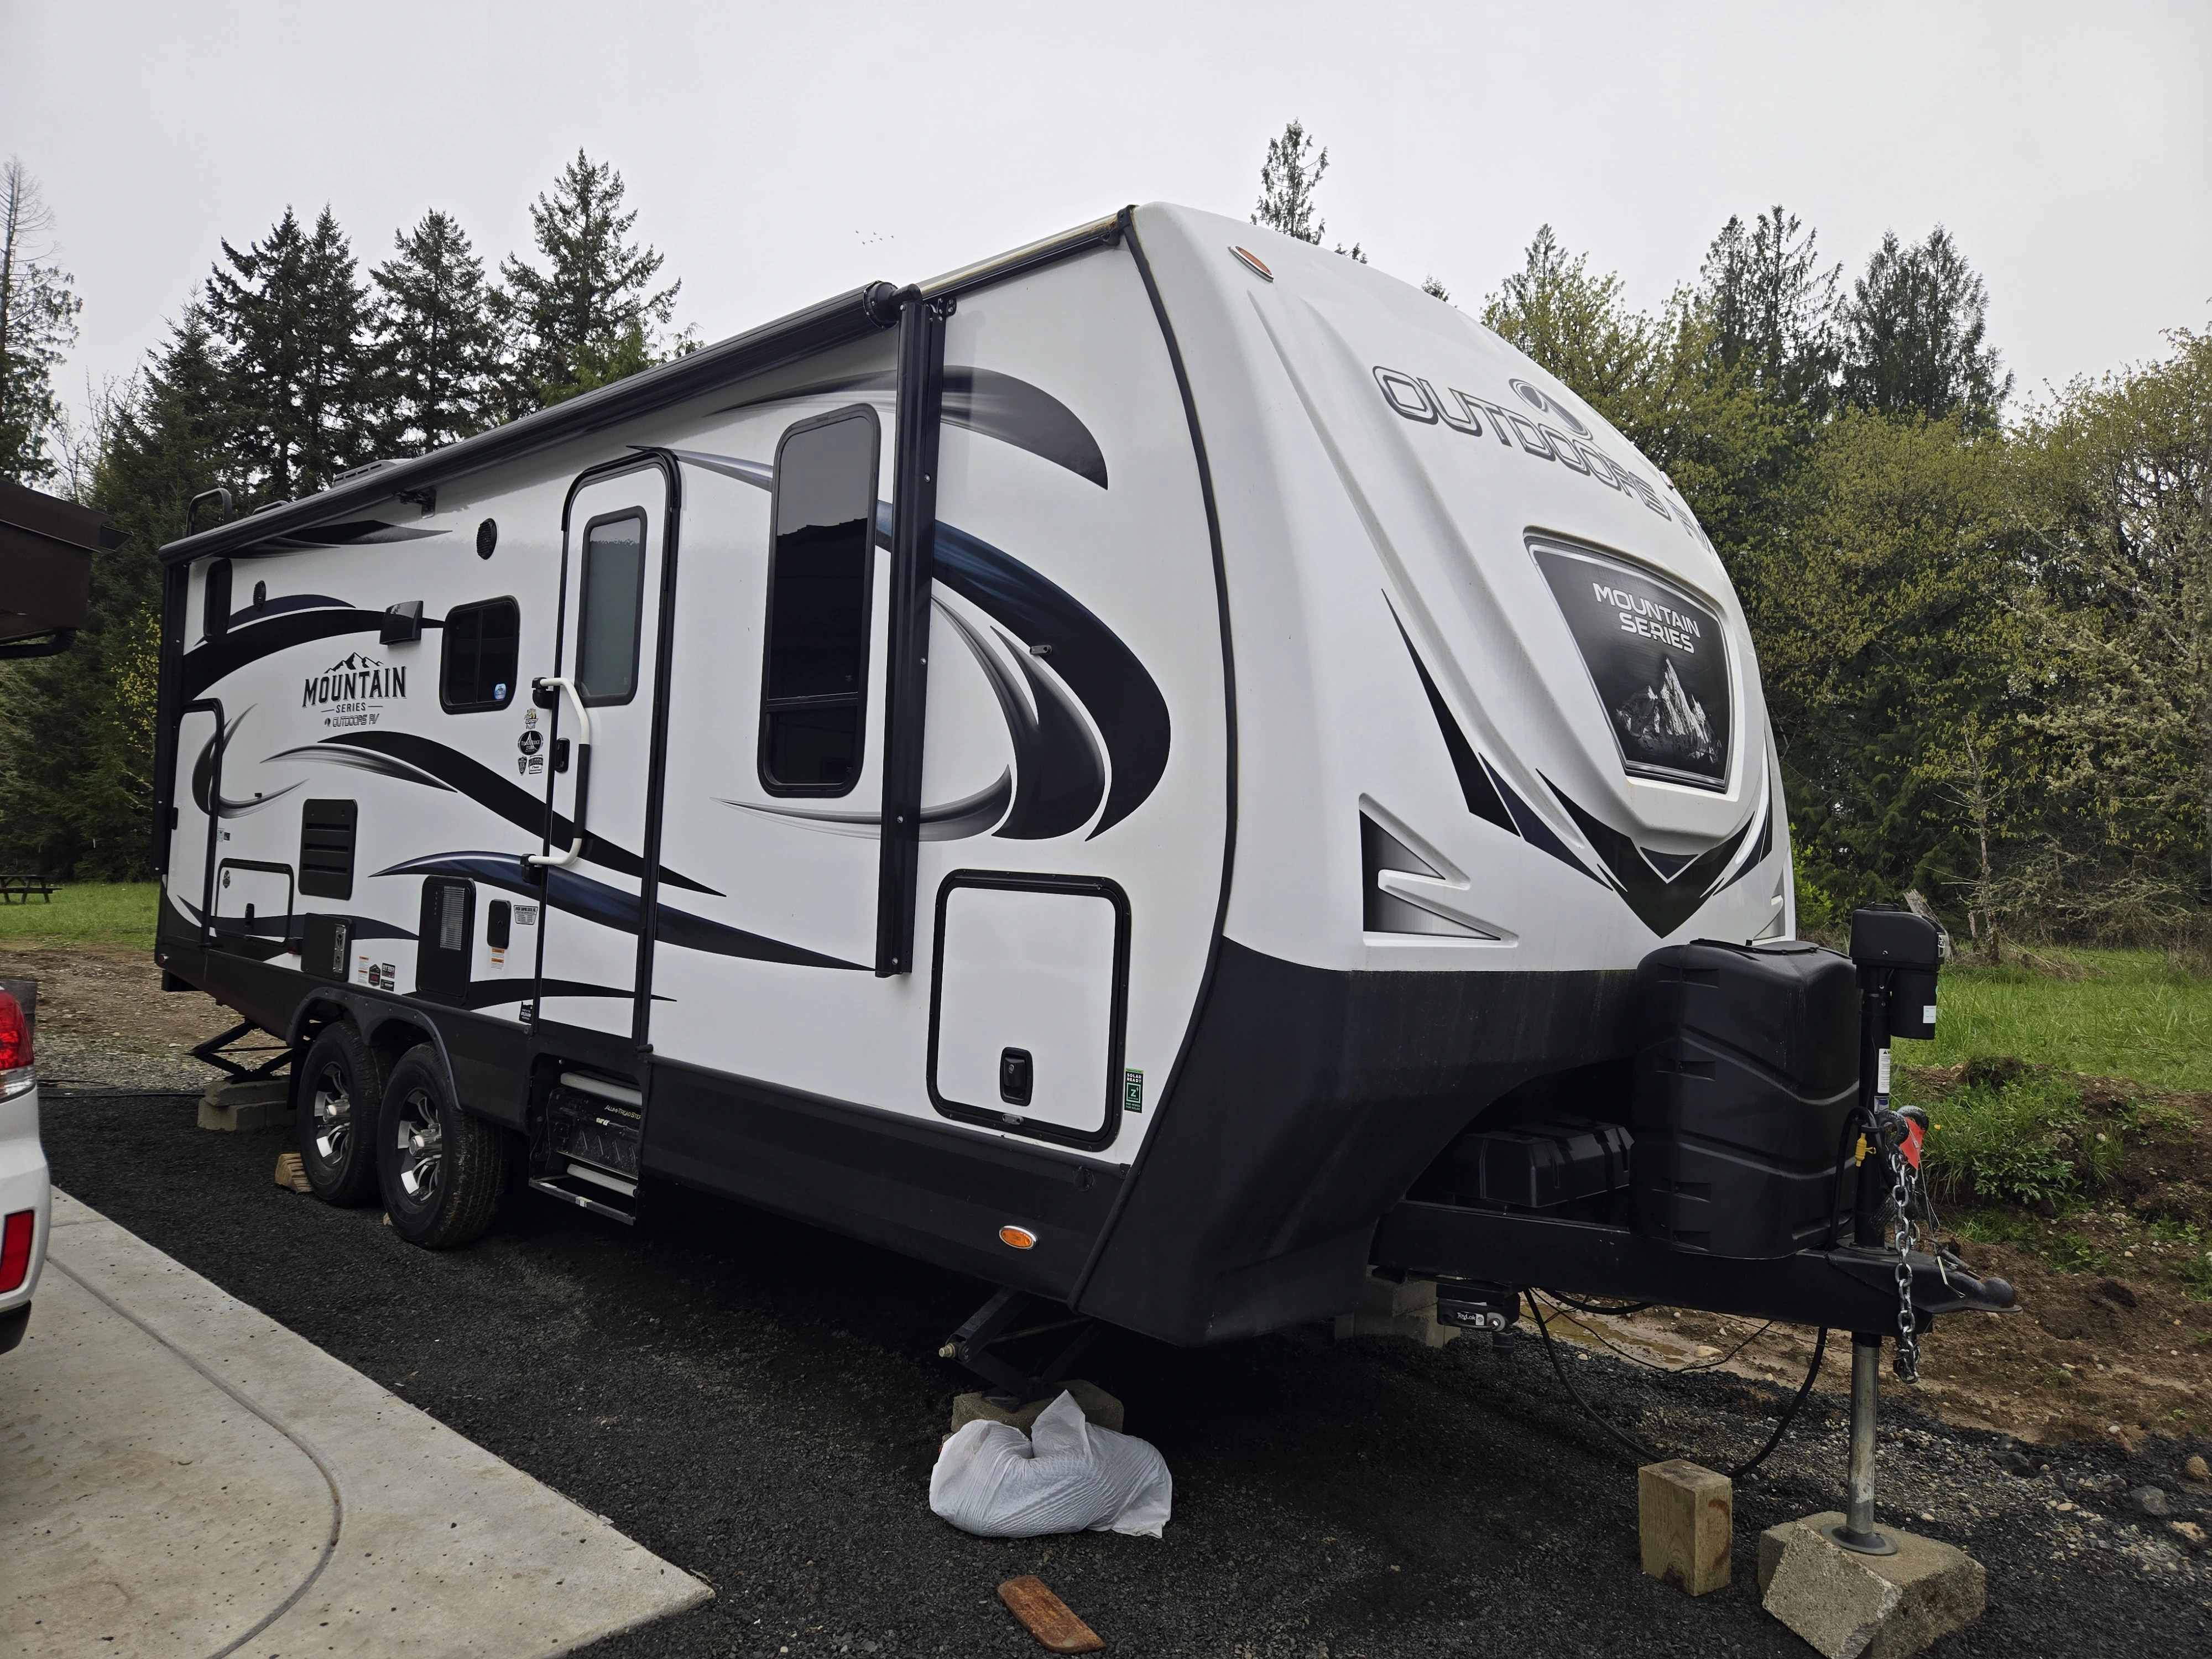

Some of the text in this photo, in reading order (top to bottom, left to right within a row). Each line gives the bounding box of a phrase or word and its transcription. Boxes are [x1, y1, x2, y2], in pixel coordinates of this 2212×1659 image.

[1373, 366, 1672, 521] OUTDOORS
[1593, 583, 1700, 638] MOUNTAIN
[1619, 612, 1694, 654] SERIES
[302, 666, 407, 708] MOUNTAIN
[336, 702, 366, 713] SERIES
[332, 713, 380, 727] OUTDOORS RV
[1457, 1312, 1476, 1321] ToyLok
